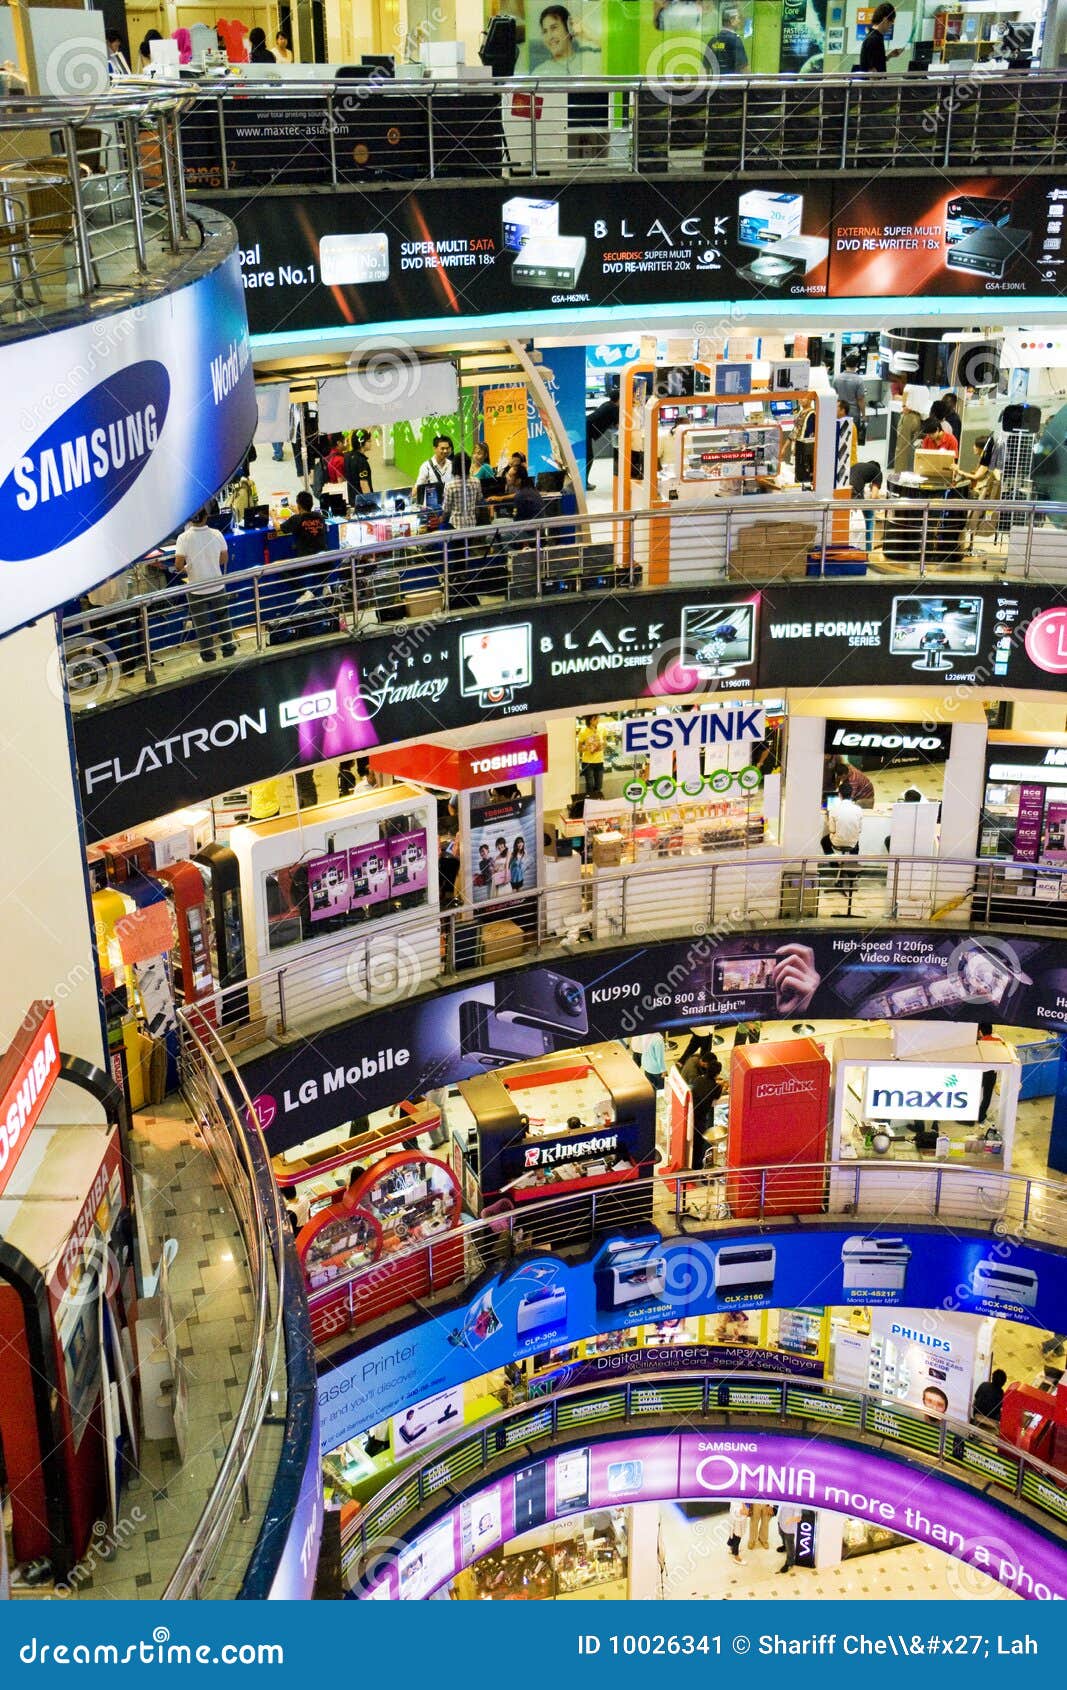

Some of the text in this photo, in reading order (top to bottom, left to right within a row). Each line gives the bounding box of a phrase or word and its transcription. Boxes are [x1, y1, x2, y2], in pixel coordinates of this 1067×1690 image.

[236, 125, 349, 137] www.maxtec-asia.om
[594, 215, 732, 246] BLACK
[837, 226, 942, 237] EXTERNAL SUPER MULTI
[401, 238, 495, 255] SUPER MULTI SATA
[603, 249, 692, 262] SECURDISC SUPER MULTI
[836, 239, 940, 250] DVD RE-WRITER 18x
[401, 255, 495, 270] DVD RE-WRITER 18x
[603, 261, 691, 273] DVD RE-WRITER 20x
[278, 265, 315, 286] No.1
[13, 404, 158, 511] SAMSUNG
[540, 623, 664, 653] BLACK
[770, 621, 882, 639] WIDE FORMAT
[848, 635, 881, 647] SERIES
[551, 652, 653, 677] DIAMOND SERIES
[625, 708, 764, 753] ESYINK
[831, 728, 942, 750] lenovo
[85, 695, 332, 795] FLATRON LCD
[470, 749, 539, 775] TOSHIBA
[833, 940, 934, 953] High-speed 120fps
[859, 952, 949, 966] Video Recording
[591, 983, 641, 1004] KU990
[653, 991, 706, 1008] ISO 800 &
[283, 1047, 411, 1113] LG Mobile
[872, 1087, 968, 1110] maxis
[541, 1134, 618, 1164] Kingston
[62, 1163, 110, 1276] TOSHIBA
[982, 1299, 1024, 1313] SCX-4200
[891, 1324, 951, 1352] PHILIPS
[362, 1343, 417, 1382] Printer
[597, 1352, 642, 1369] Digital
[646, 1347, 709, 1360] Camera
[725, 1347, 780, 1361] MP3/MP4
[782, 1355, 818, 1370] Player
[698, 1442, 757, 1453] SAMSUNG
[696, 1454, 816, 1499] OMNIA
[824, 1485, 896, 1520] more
[904, 1507, 965, 1551] than
[974, 1544, 990, 1567] a
[799, 1521, 812, 1556] VAIO
